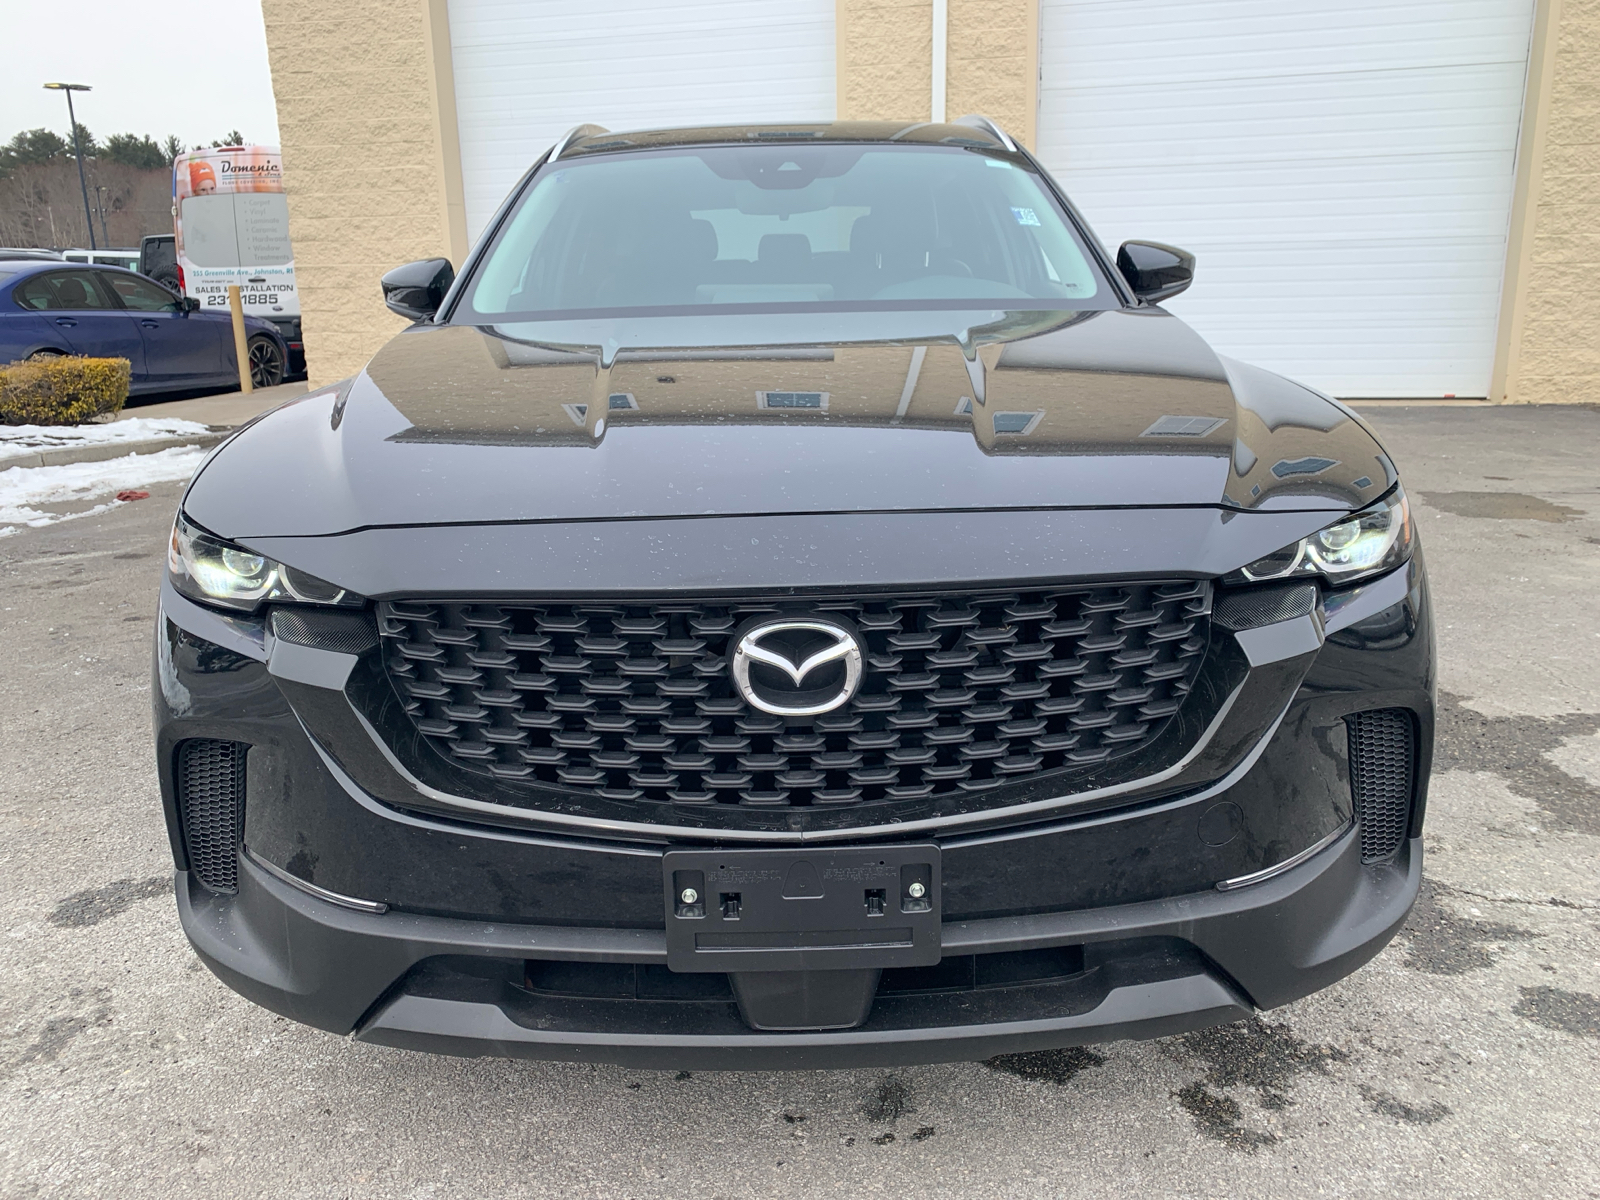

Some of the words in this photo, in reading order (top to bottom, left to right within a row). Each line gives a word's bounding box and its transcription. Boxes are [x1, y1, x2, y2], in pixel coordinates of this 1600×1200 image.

[221, 160, 280, 173] Domenic
[248, 199, 270, 207] Carpet
[249, 207, 266, 216] Vinyl
[252, 234, 288, 242] Hardwood
[253, 267, 285, 275] Johnston,
[195, 286, 221, 294] SALES
[239, 284, 294, 293] STALLATION
